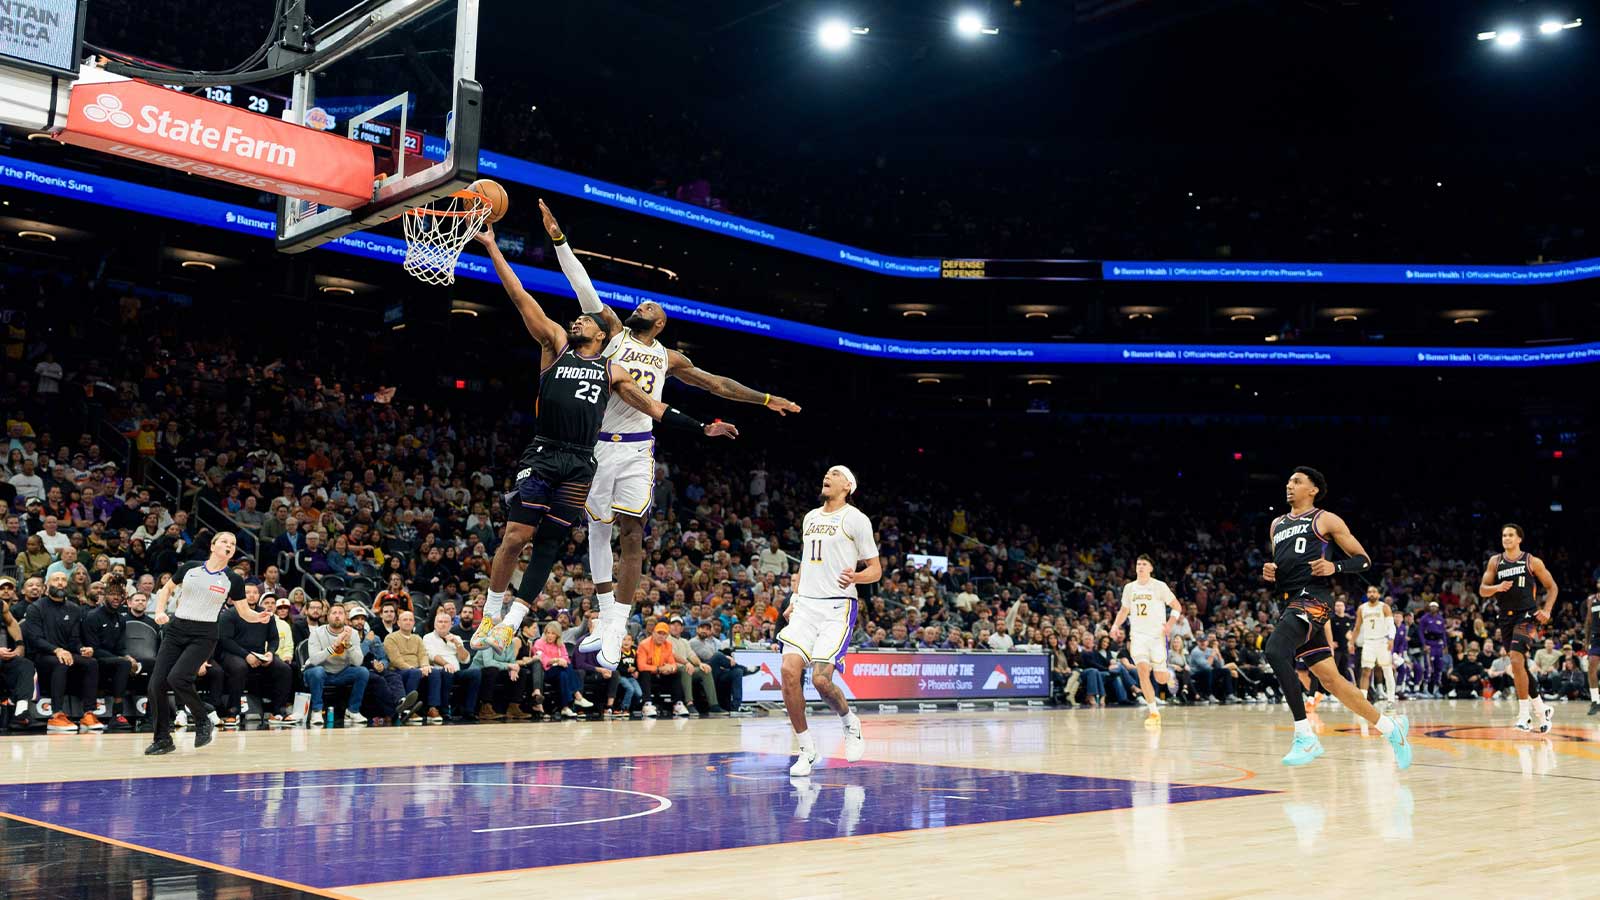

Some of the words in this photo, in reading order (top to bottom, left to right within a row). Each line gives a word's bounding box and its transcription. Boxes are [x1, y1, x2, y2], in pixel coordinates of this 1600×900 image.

[205, 87, 232, 104] 1:04
[248, 95, 269, 113] 29
[361, 121, 391, 136] TIMEOUTS
[360, 132, 380, 144] FOULS
[425, 144, 435, 153] of
[480, 157, 498, 169] Suns
[5, 167, 24, 179] the
[25, 170, 67, 188] Phoenix
[68, 179, 94, 193] Suns
[237, 214, 271, 230] Banner
[340, 237, 366, 249] Health
[366, 241, 387, 253] Care
[387, 245, 407, 257] Partn
[469, 261, 488, 273] Suns
[619, 347, 664, 370] LAKERS
[555, 366, 605, 381] PHOENIX
[574, 380, 602, 404] 23
[804, 522, 839, 537] LAKERS
[1273, 523, 1310, 545] PHOENIX
[810, 540, 823, 563] 11
[1294, 536, 1307, 554] 0
[1498, 565, 1526, 580] PHOENIX
[1518, 576, 1526, 588] 11
[1136, 603, 1148, 616] 12
[1369, 618, 1376, 630] 7
[853, 663, 890, 676] OFFICIAL
[891, 663, 921, 676] CREDIT
[921, 663, 947, 676] UNION
[948, 663, 959, 676] OF
[959, 663, 975, 676] THE
[1011, 666, 1045, 675] MOUNTAIN
[927, 679, 955, 690] Phoenix
[955, 679, 973, 690] Suns
[1013, 675, 1043, 684] AMERICA
